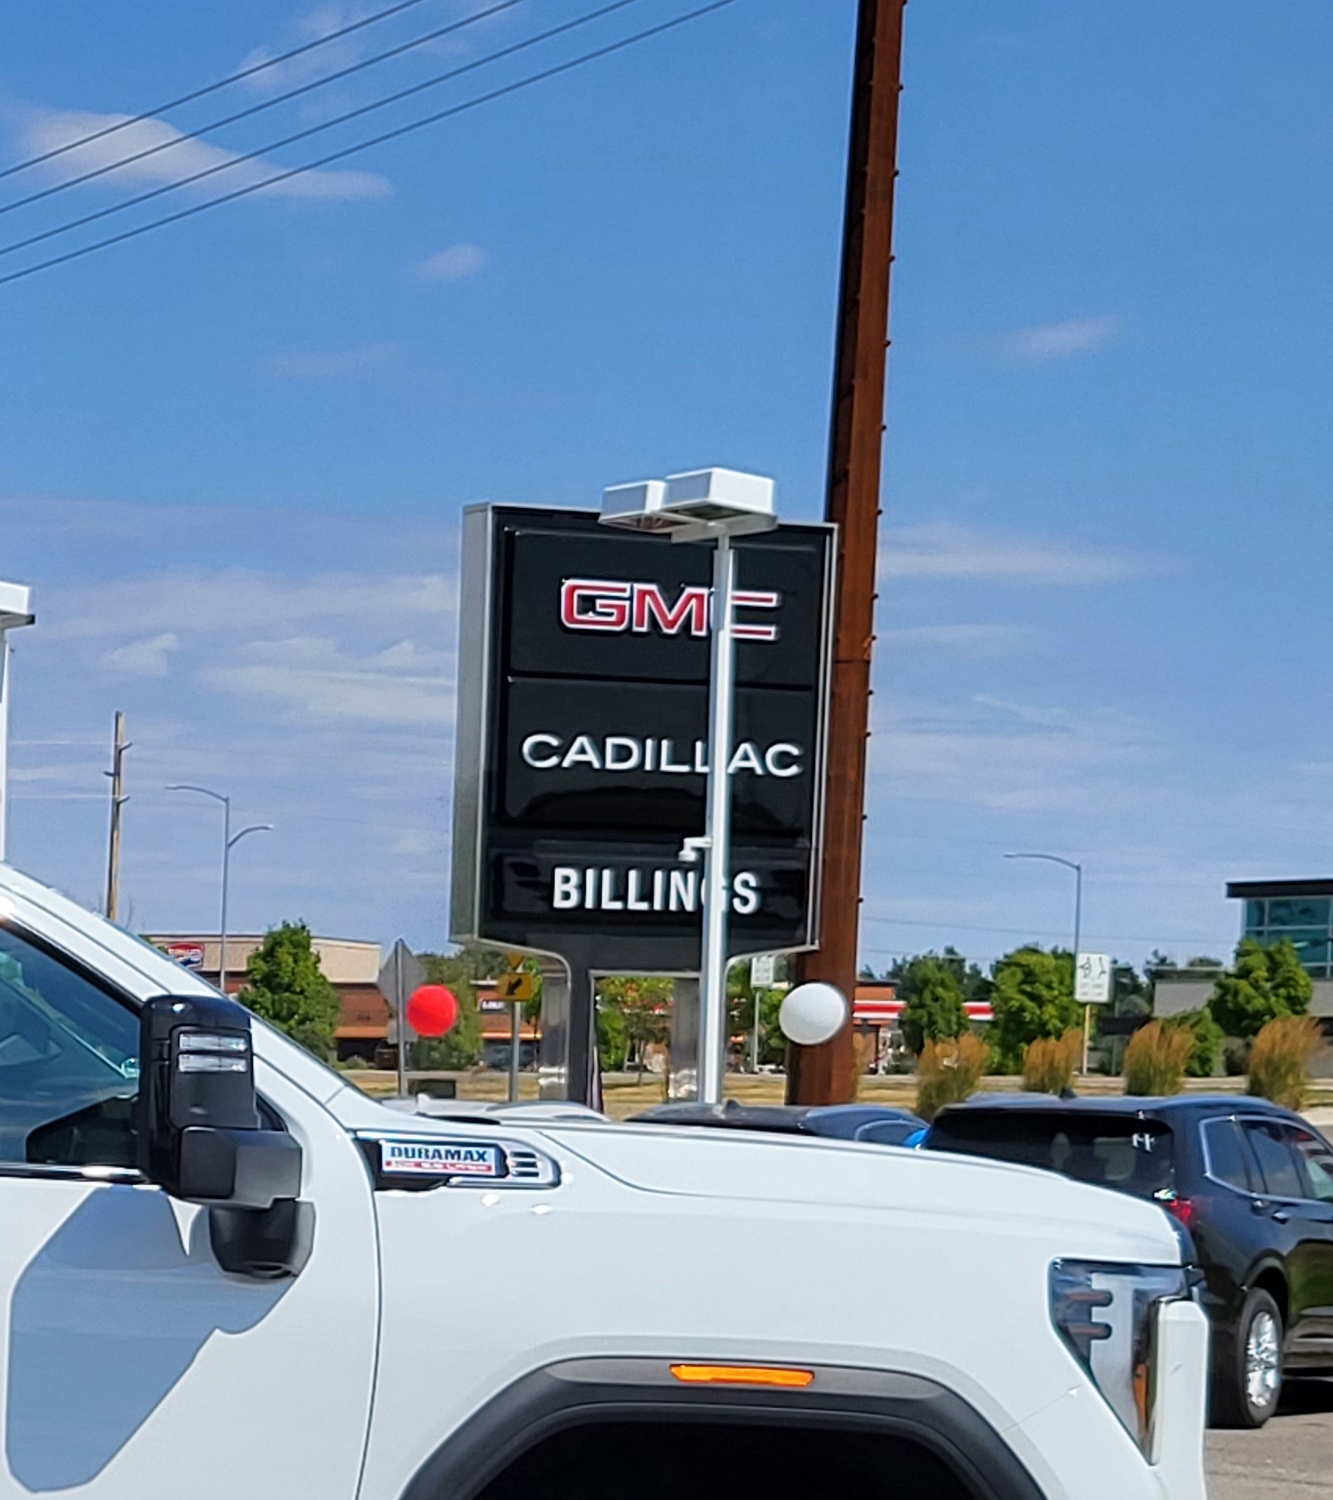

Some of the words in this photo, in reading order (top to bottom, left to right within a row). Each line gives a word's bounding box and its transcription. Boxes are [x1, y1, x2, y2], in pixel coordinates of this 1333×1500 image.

[560, 577, 778, 641] GMC
[522, 733, 804, 778] CADILLAC
[391, 1147, 488, 1162] DURAMAX
